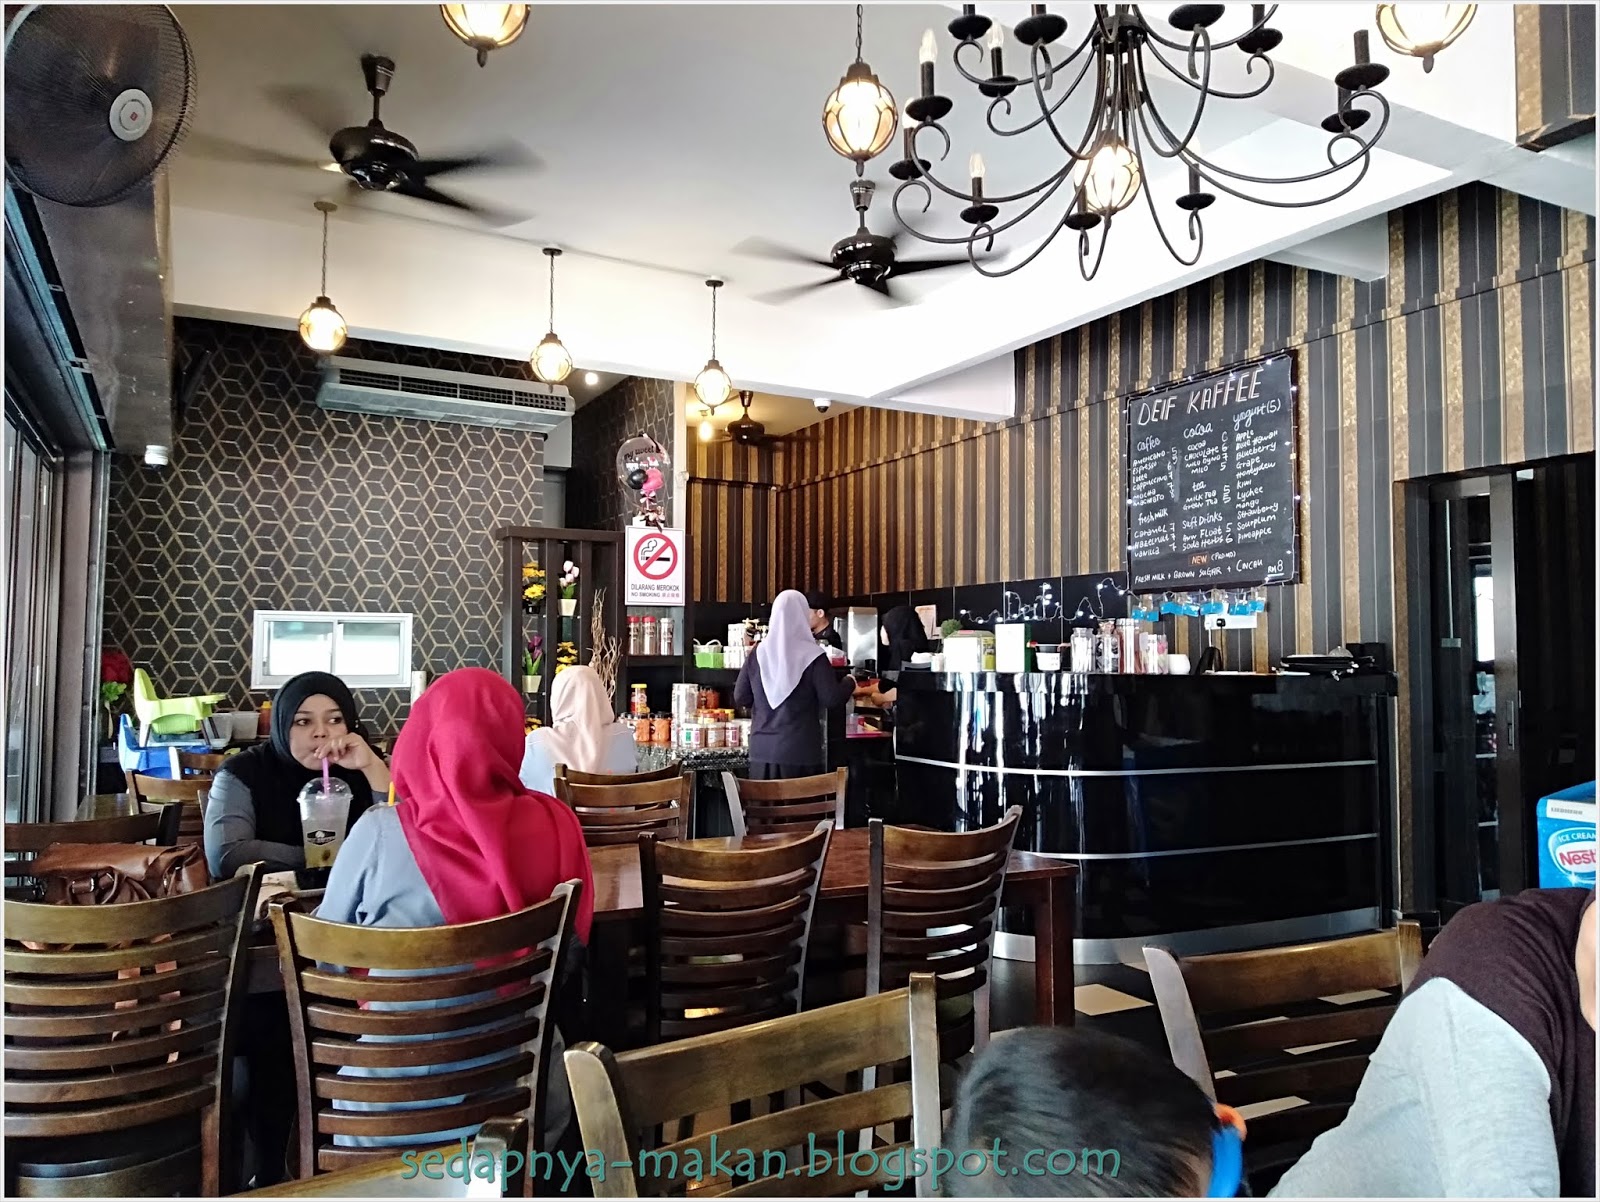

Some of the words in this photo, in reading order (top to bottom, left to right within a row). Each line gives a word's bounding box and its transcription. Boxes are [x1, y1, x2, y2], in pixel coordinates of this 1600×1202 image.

[1138, 396, 1177, 425] DEIF
[1187, 368, 1264, 414] KAFFEE
[1222, 443, 1228, 452] 6
[1236, 442, 1276, 460] Blueberry
[1220, 462, 1227, 471] 5
[1236, 456, 1260, 470] Grape
[1224, 485, 1230, 494] 5
[1237, 486, 1264, 502] Lychee
[1223, 494, 1231, 504] 5
[1237, 502, 1279, 520] Strawberry
[1199, 511, 1223, 526] Drinks
[1237, 514, 1276, 531] Sourplum
[1169, 523, 1175, 532] 7
[1226, 522, 1233, 533] 5
[1225, 533, 1233, 544] 6
[1169, 542, 1177, 552] 7
[1191, 555, 1208, 565] NEW
[1134, 573, 1150, 585] FRESH
[1152, 573, 1166, 581] MILK
[1174, 570, 1195, 579] BROWN
[1199, 566, 1222, 578] SUGAR
[656, 584, 680, 592] MEROKOK
[1558, 834, 1571, 843] ICE
[1559, 849, 1596, 866] Nest
